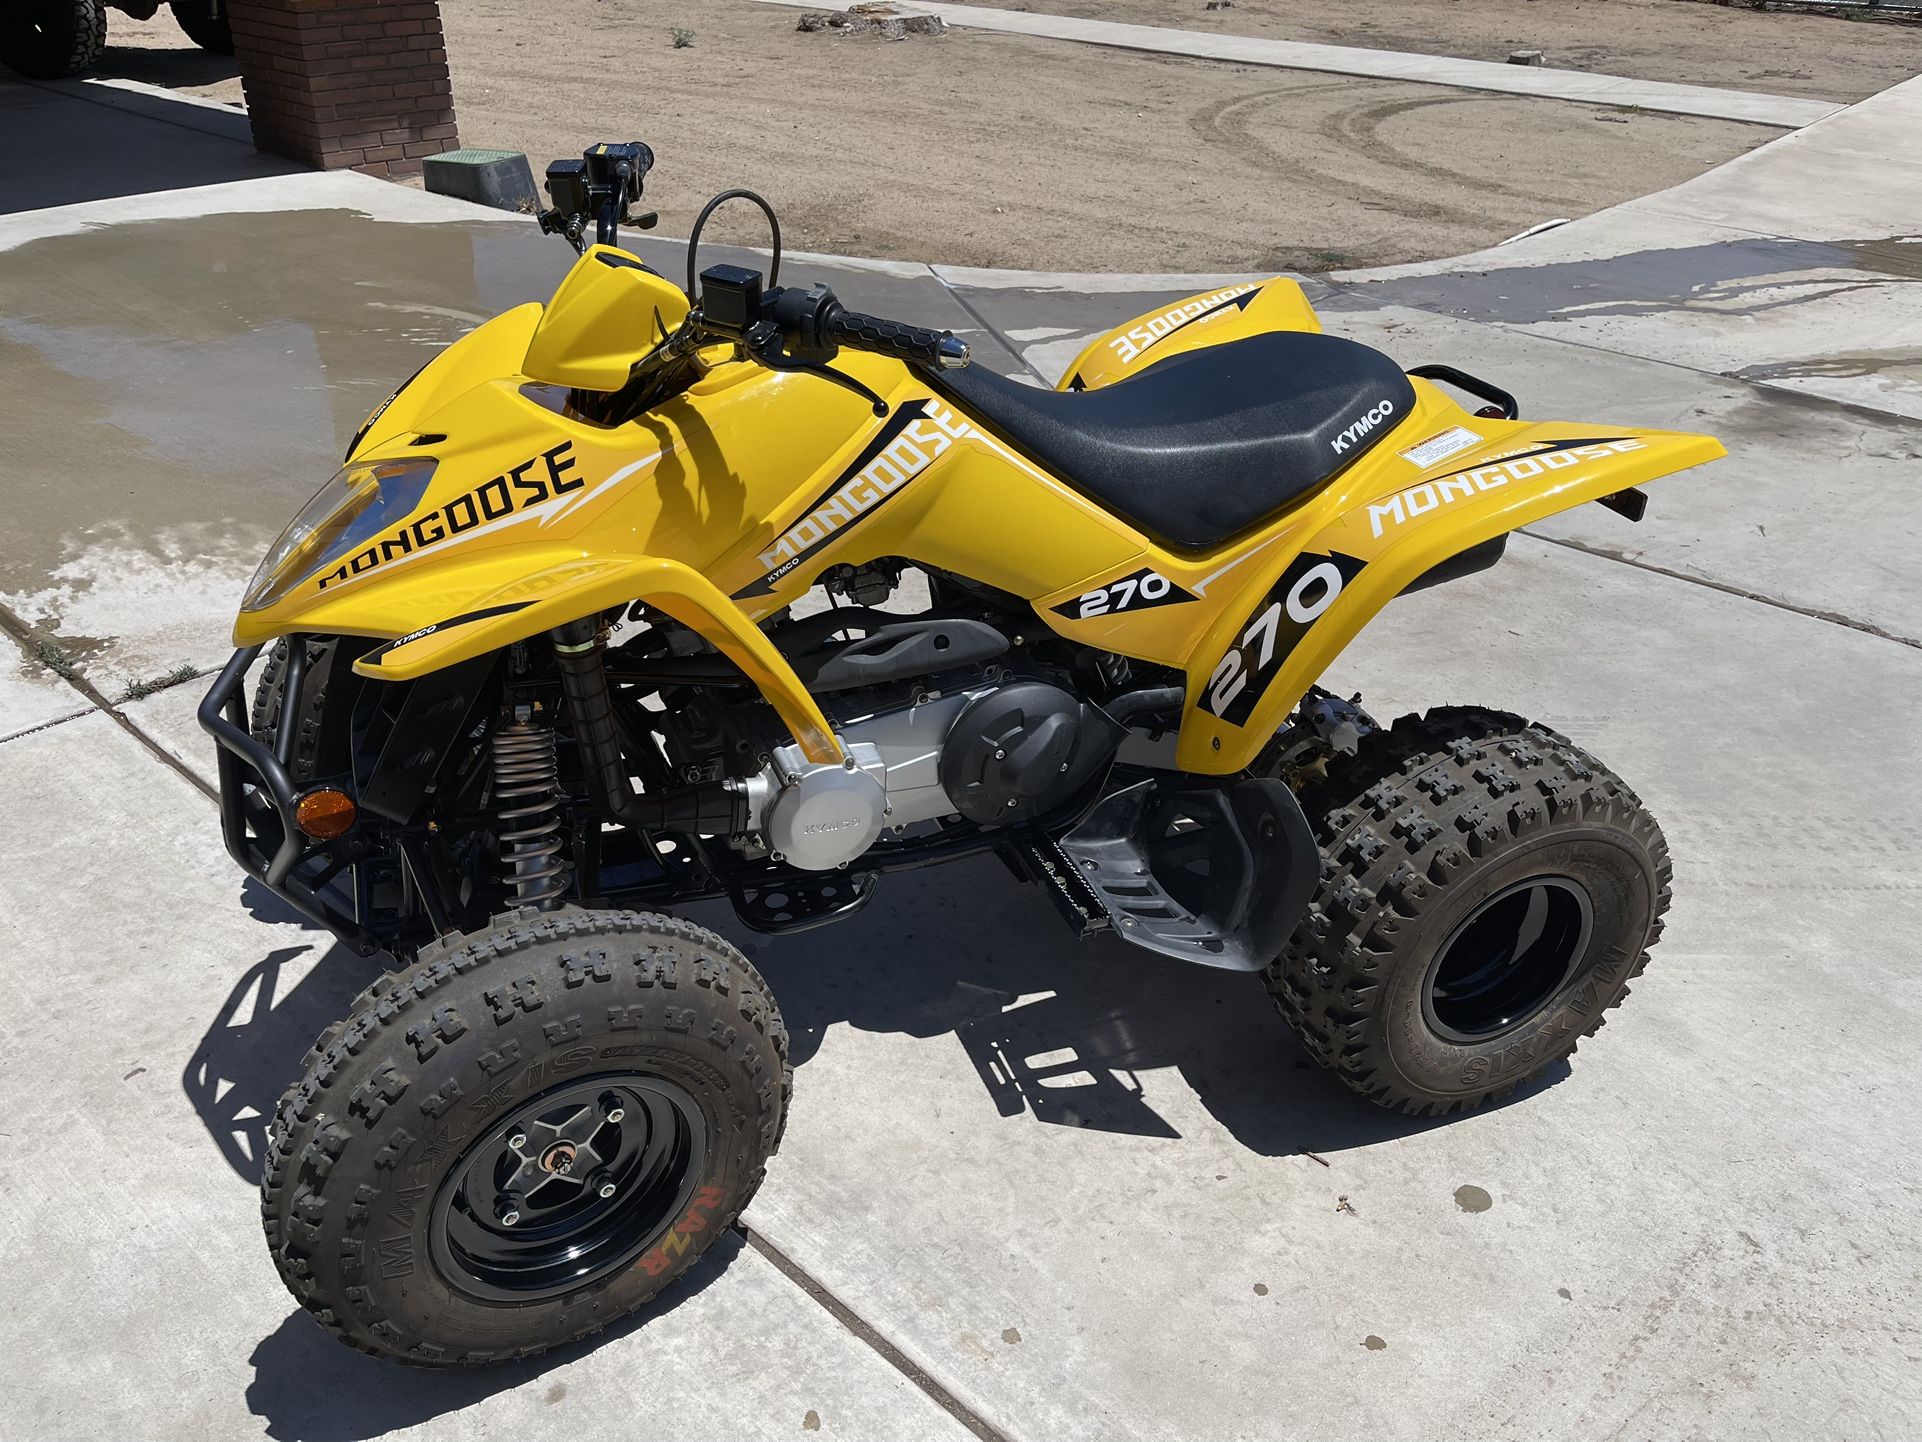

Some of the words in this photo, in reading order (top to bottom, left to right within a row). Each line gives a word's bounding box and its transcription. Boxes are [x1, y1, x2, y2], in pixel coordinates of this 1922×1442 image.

[1109, 284, 1256, 364] MONGOOSE
[1331, 400, 1394, 454] KYMCO
[1481, 444, 1544, 463] KYMCO
[318, 440, 585, 589] MONGOOSE
[756, 400, 971, 570] MONGOOSE
[1366, 439, 1648, 538] MONGOOSE
[767, 557, 800, 582] KYMCO
[1079, 572, 1171, 619] 270
[393, 625, 437, 647] KYMCO
[1208, 562, 1343, 718] 270
[803, 818, 861, 835] KYMCO
[1461, 944, 1630, 1085] MAXXIS
[379, 1045, 599, 1280] MAXXIS
[636, 1186, 726, 1277] RAZR
